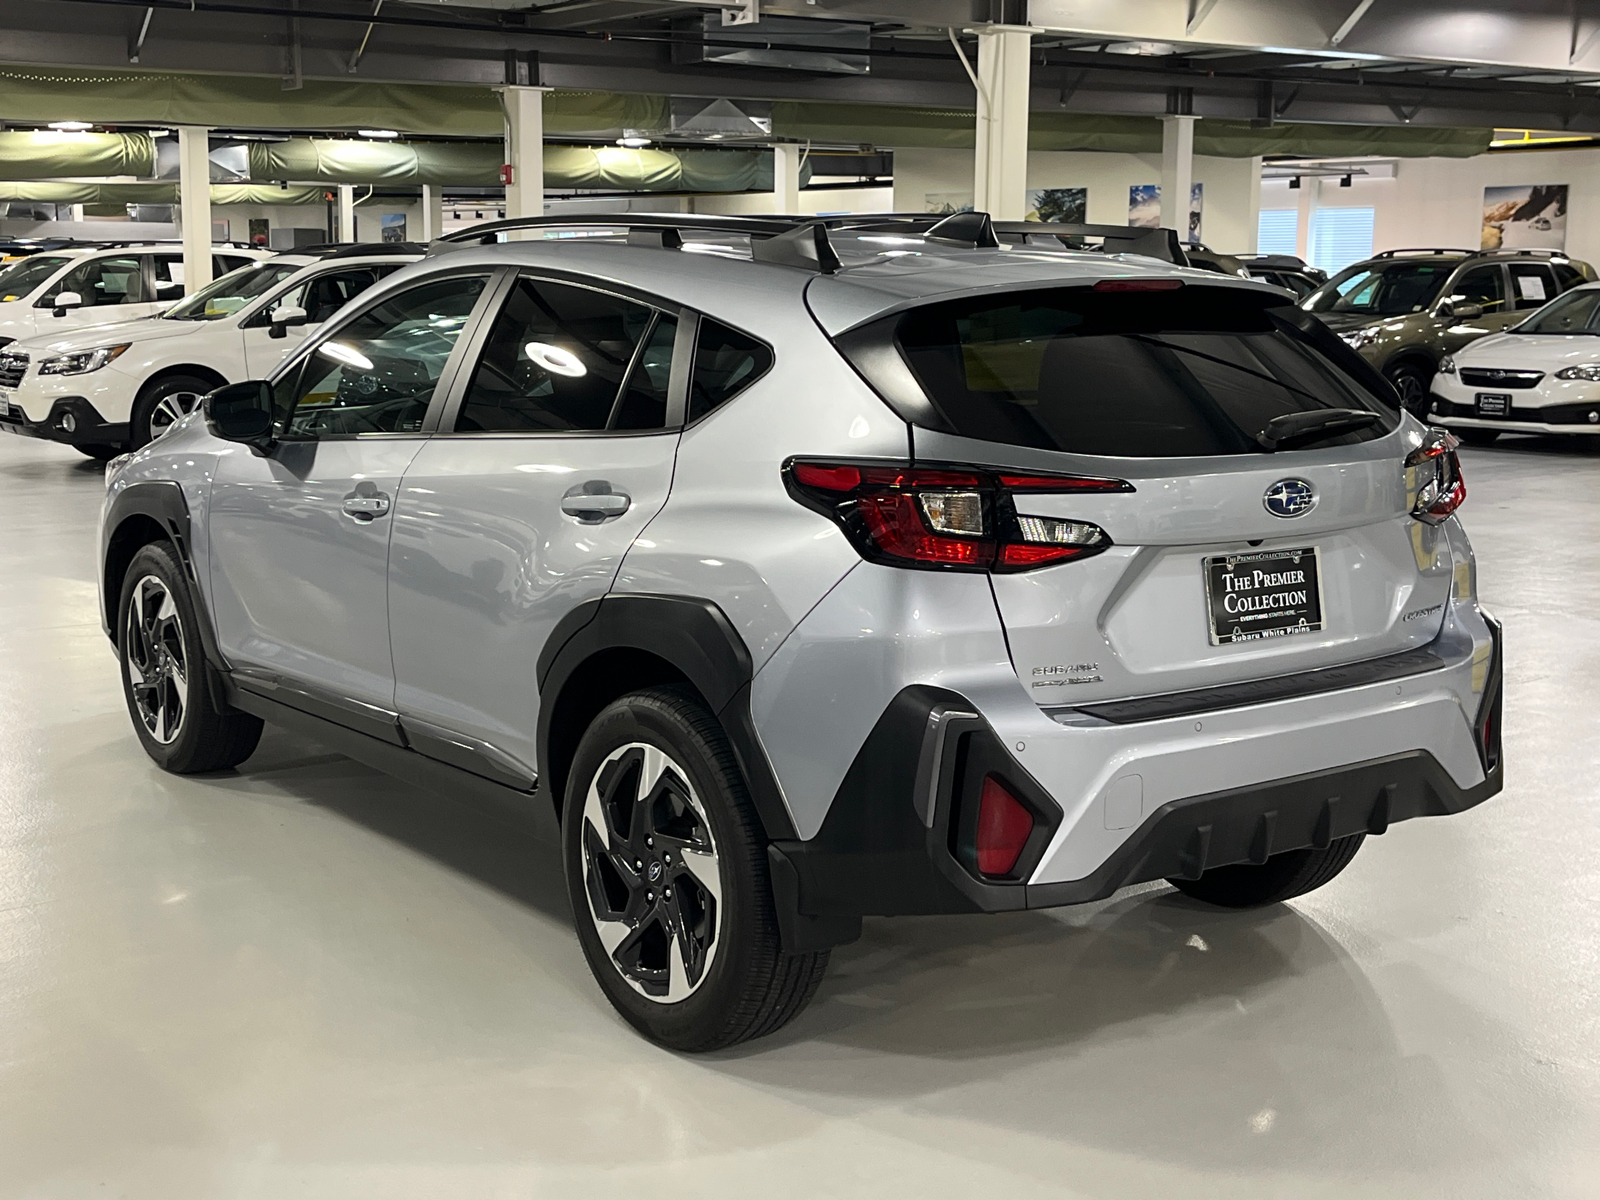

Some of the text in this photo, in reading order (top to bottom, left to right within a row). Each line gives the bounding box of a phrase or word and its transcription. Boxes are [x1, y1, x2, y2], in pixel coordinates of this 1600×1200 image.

[1252, 570, 1305, 588] PREMIER
[1223, 590, 1307, 613] COLLECTION
[1231, 626, 1310, 642] Subaru White Plains
[1032, 662, 1099, 676] SUBARU
